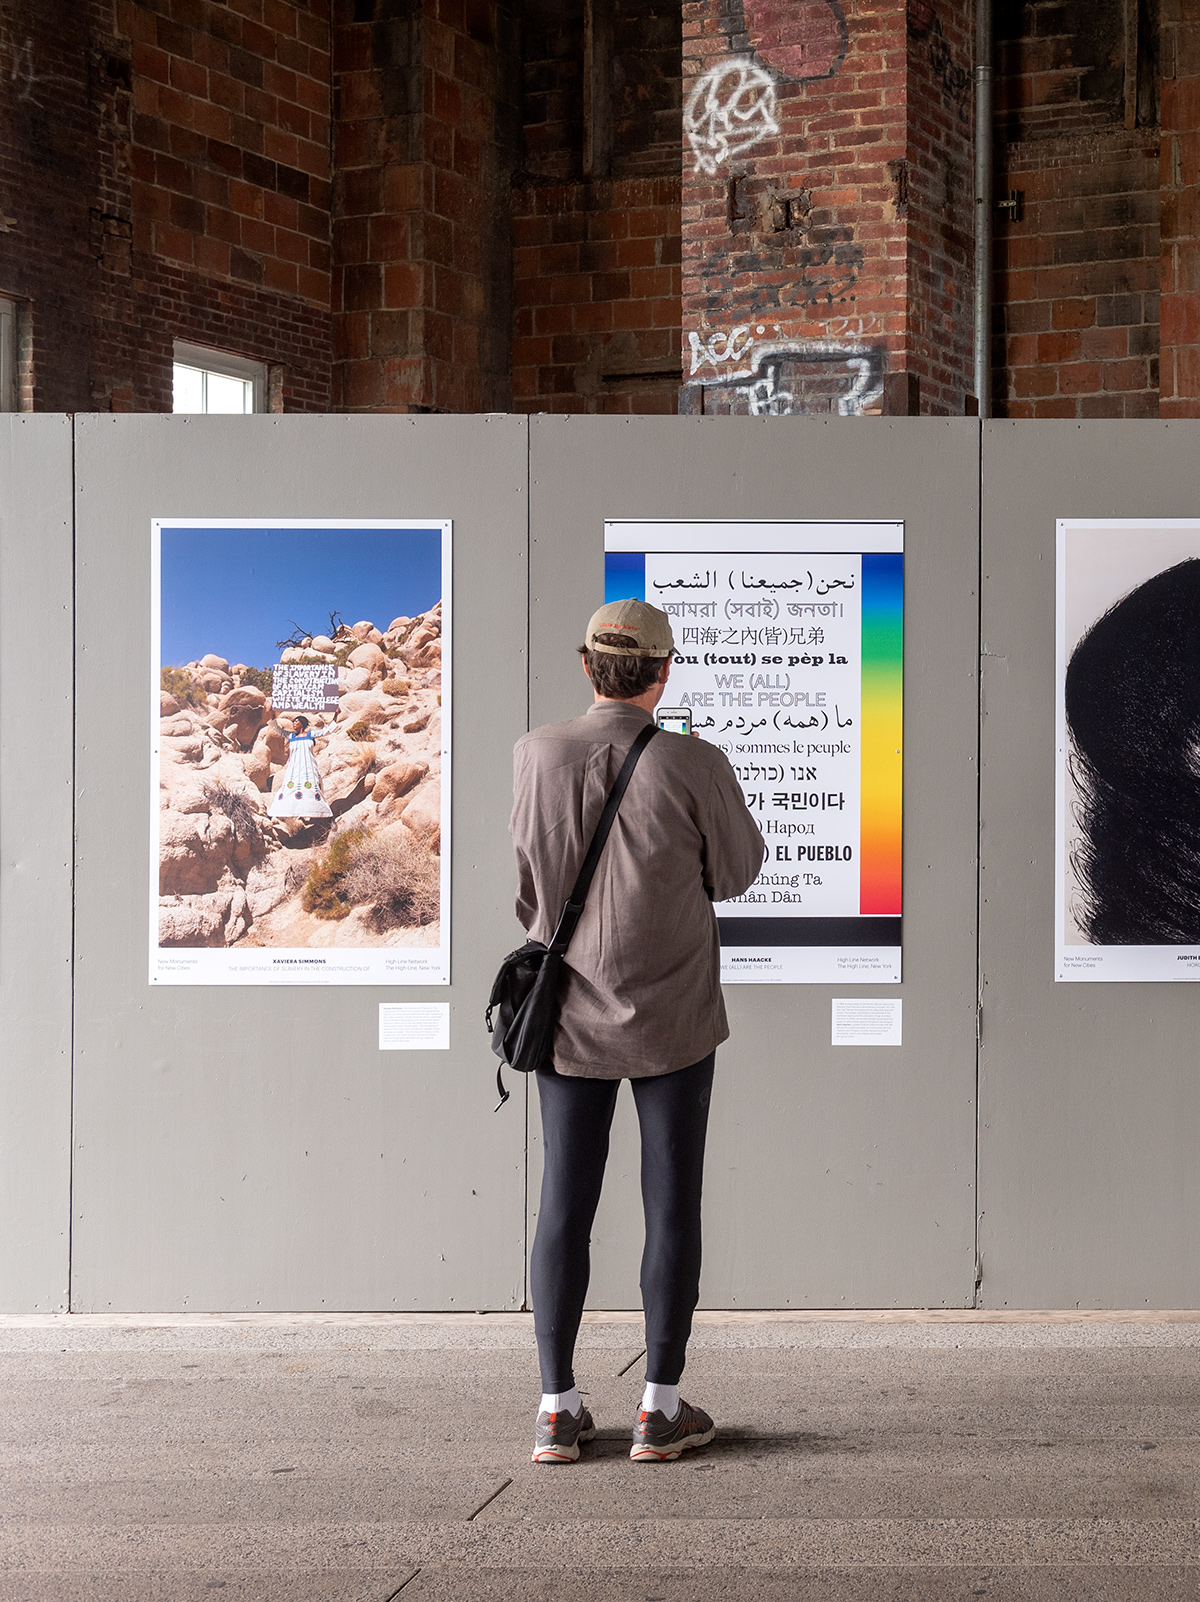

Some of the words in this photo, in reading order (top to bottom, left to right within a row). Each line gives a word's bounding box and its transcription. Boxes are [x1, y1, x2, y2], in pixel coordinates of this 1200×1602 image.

[672, 654, 698, 665] ou
[704, 652, 756, 666] (tout)
[761, 655, 782, 665] se
[788, 652, 824, 666] pèp
[828, 653, 848, 665] la
[714, 674, 744, 689] WE
[749, 672, 790, 690] (ALL)
[680, 692, 714, 706] ARE
[719, 692, 753, 706] THE
[758, 692, 826, 707] PEOPLE
[736, 742, 790, 753] sommes
[793, 740, 804, 753] le
[807, 740, 851, 757] peuple
[790, 766, 817, 781] אנו
[772, 792, 845, 810] 국민이다
[767, 820, 815, 837] Народ
[776, 845, 792, 861] EL
[798, 845, 852, 861] PUEBLO
[803, 873, 823, 885] Ta
[771, 891, 802, 903] Dân
